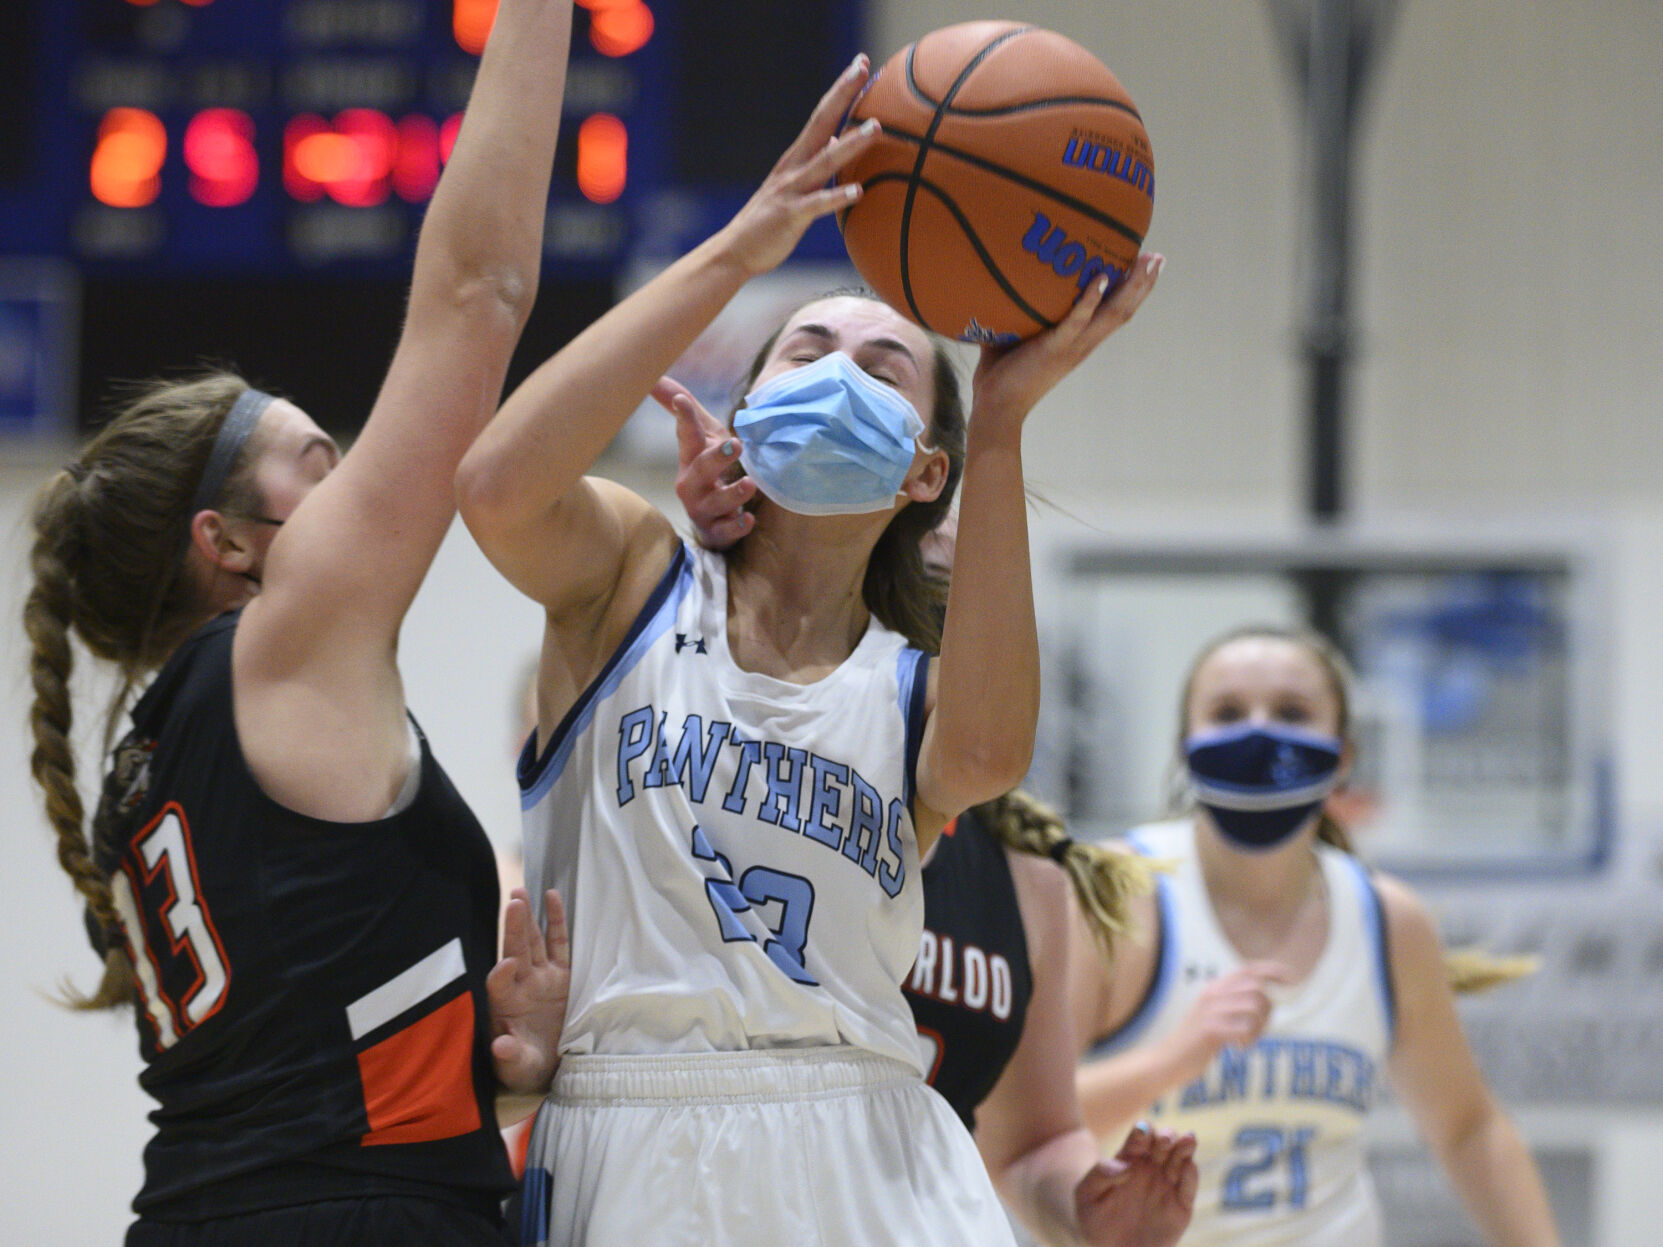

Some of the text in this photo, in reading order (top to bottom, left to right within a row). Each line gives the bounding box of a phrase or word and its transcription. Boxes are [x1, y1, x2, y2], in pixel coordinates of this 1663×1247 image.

[616, 703, 906, 899] PANTHERS
[109, 800, 231, 1052] 13
[902, 927, 1013, 1022] RLOO
[1219, 1124, 1317, 1213] 21
